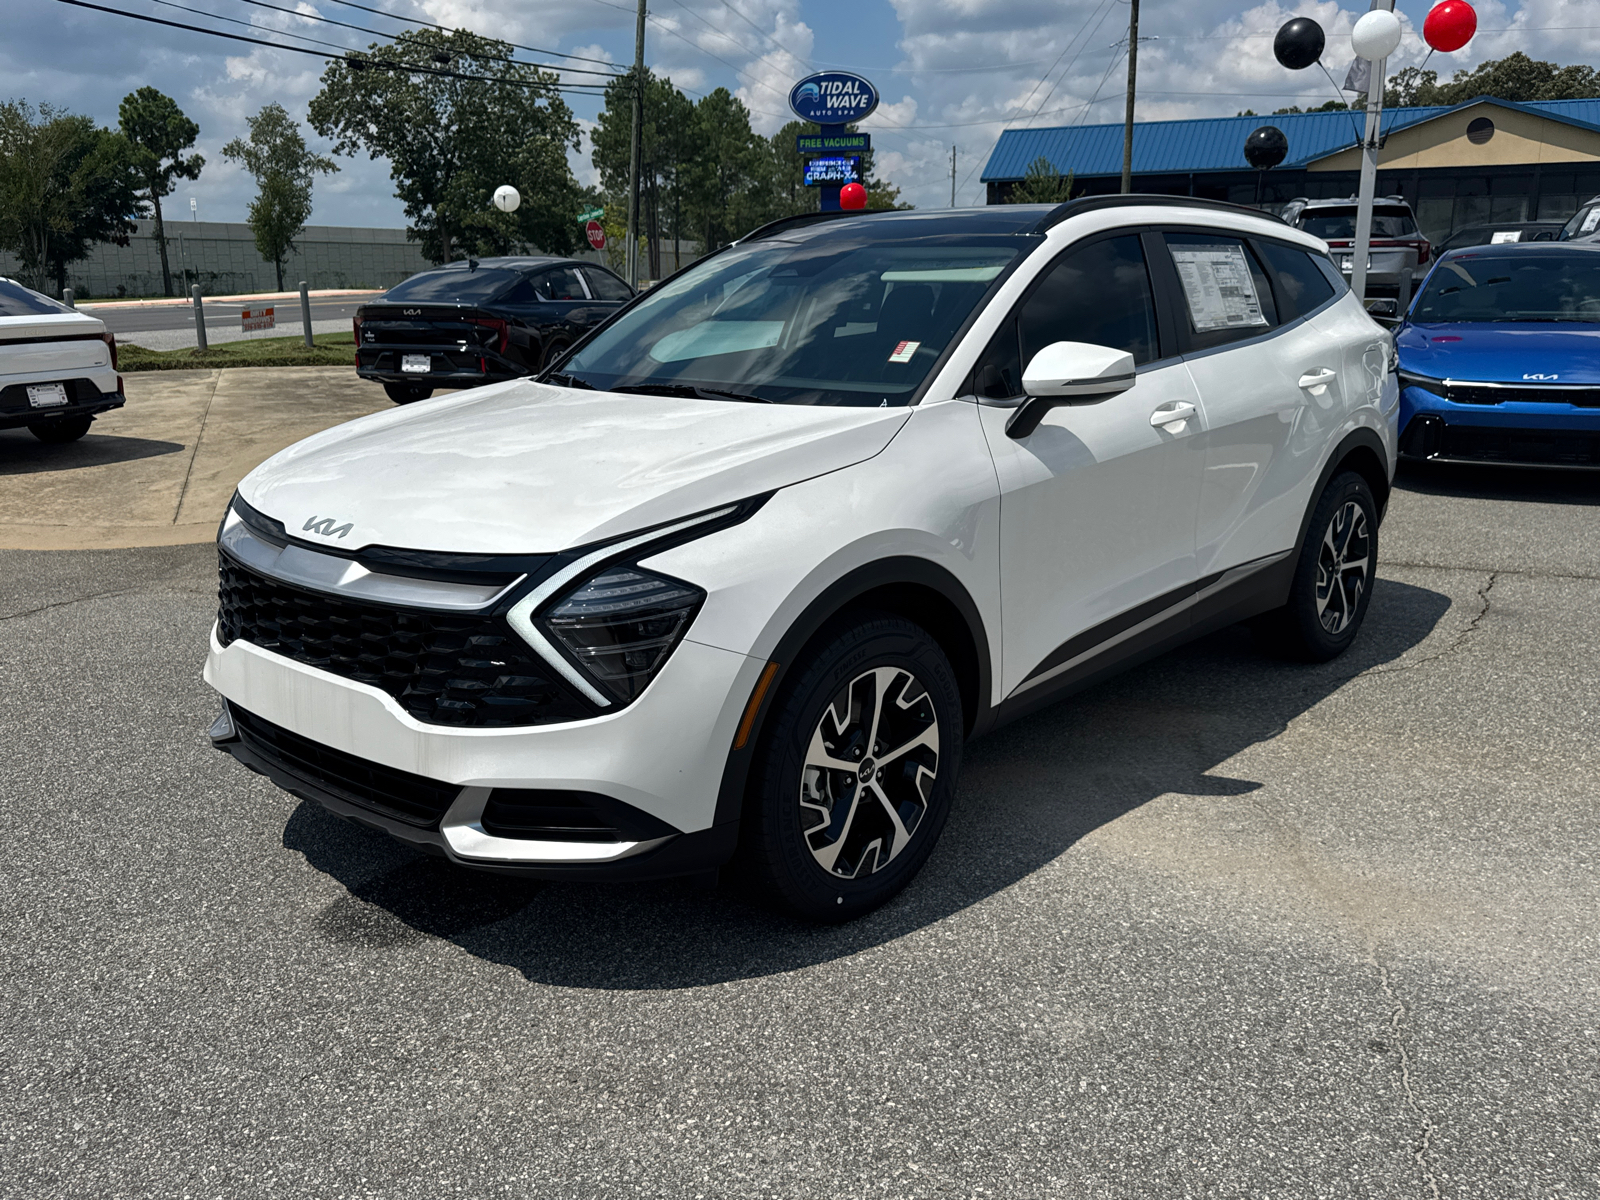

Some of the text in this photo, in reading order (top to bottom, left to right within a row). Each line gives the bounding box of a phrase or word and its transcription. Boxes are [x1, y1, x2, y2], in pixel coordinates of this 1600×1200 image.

[820, 81, 860, 95] TIDAL
[826, 94, 869, 109] WAVE
[800, 136, 865, 148] FREE VACUUMS
[806, 170, 859, 181] GRAPH-X4
[588, 230, 603, 241] STOP
[403, 308, 422, 316] KIA
[1522, 373, 1559, 381] KIA
[302, 515, 355, 539] KIA
[833, 647, 867, 681] FINESSE
[860, 763, 876, 779] KIA
